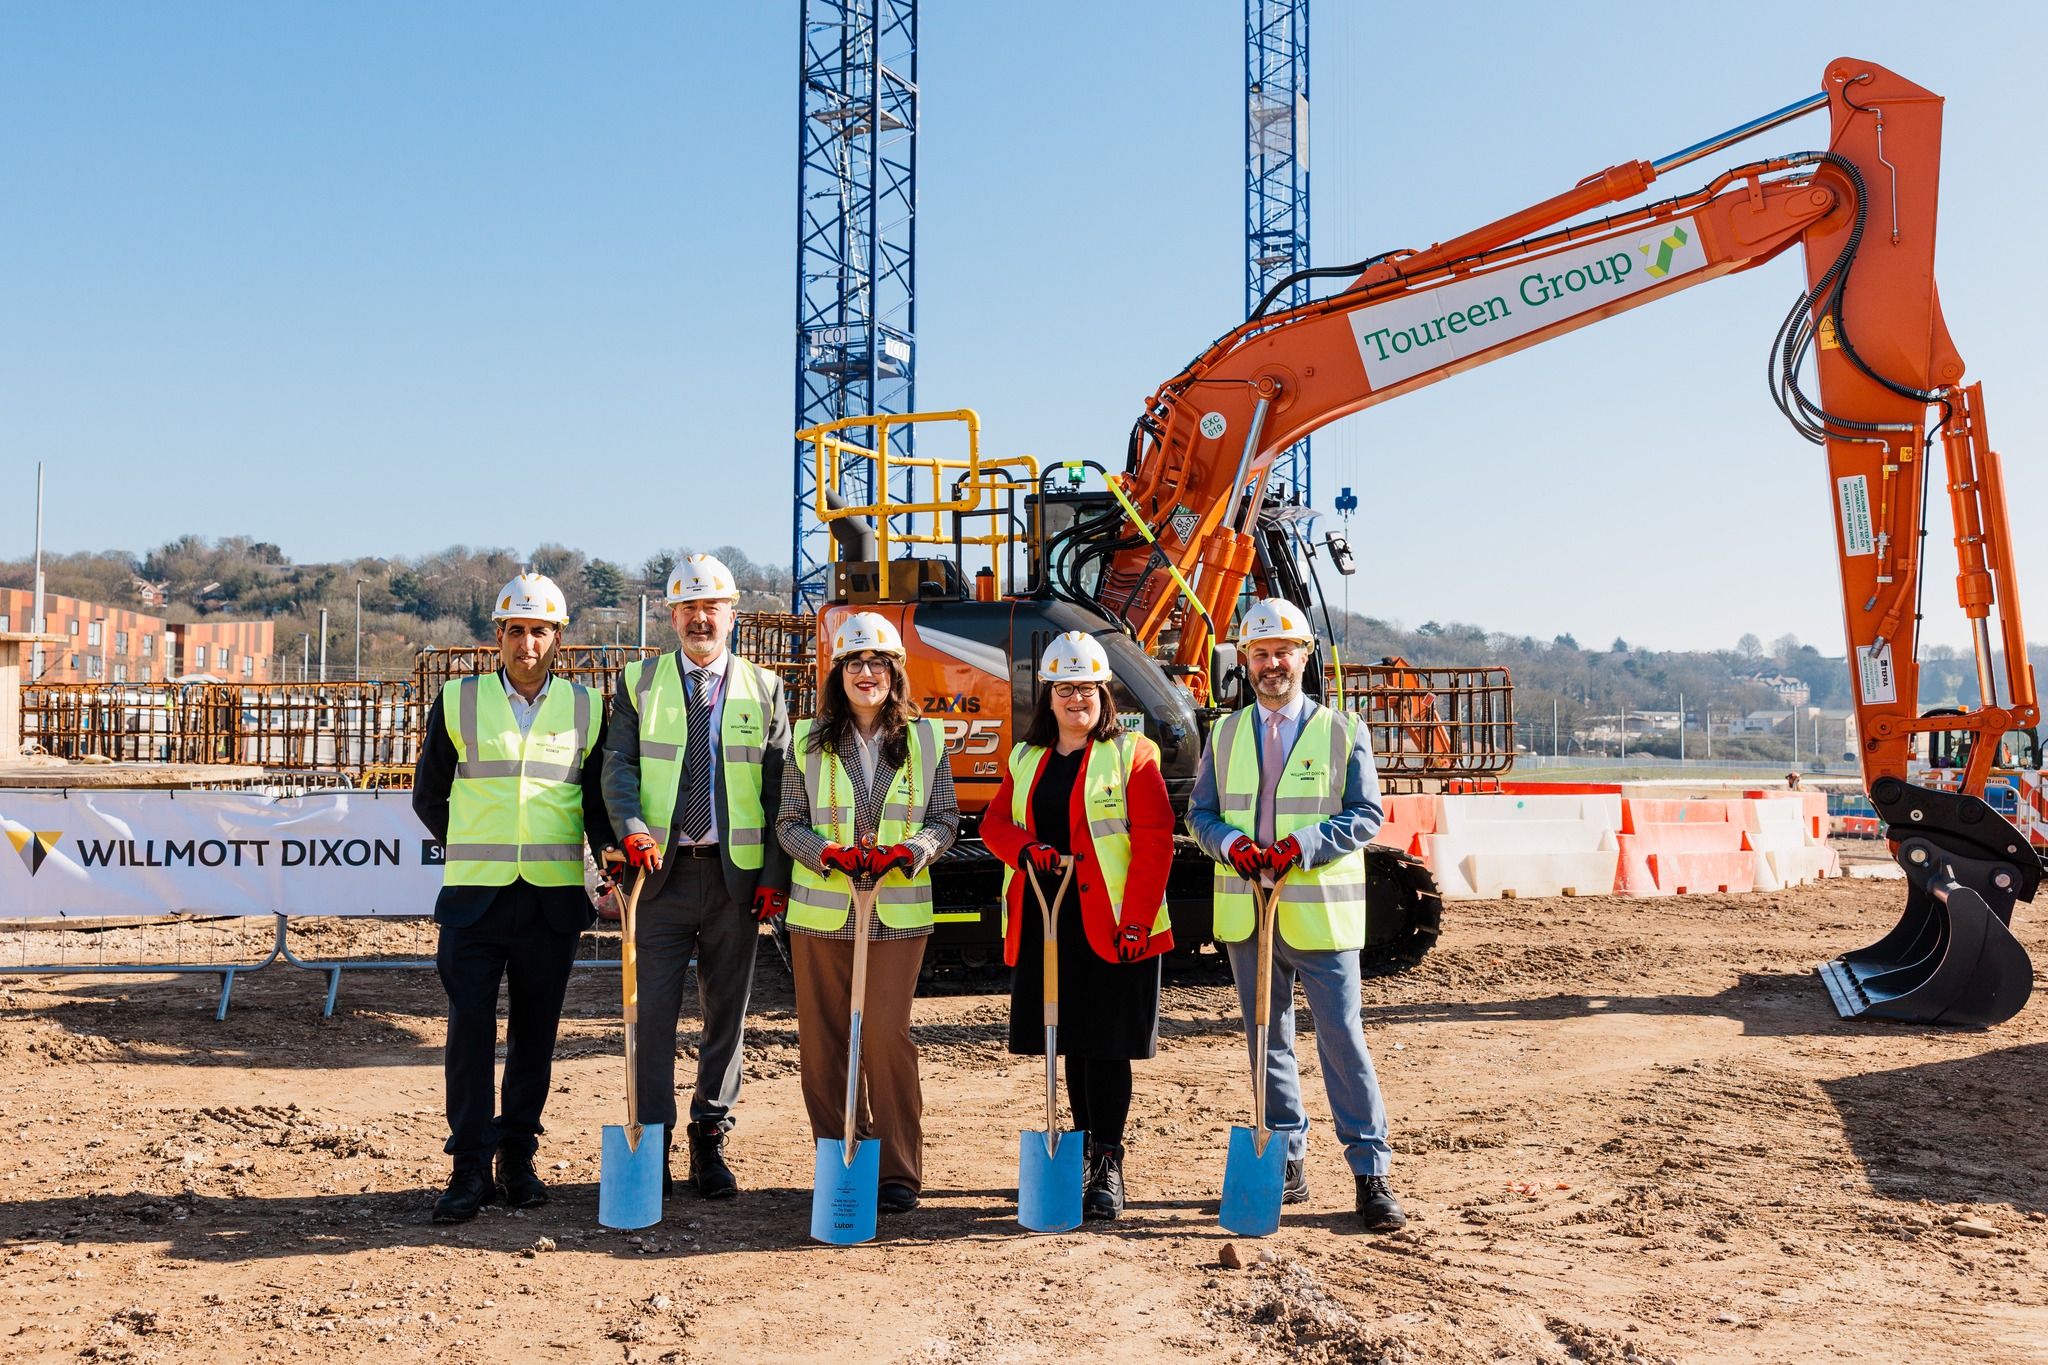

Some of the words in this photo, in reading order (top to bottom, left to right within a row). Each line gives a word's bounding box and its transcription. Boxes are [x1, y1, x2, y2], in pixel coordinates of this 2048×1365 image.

[1364, 296, 1512, 361] Toureen
[1519, 252, 1633, 307] Group
[814, 328, 848, 344] TC01
[1202, 415, 1220, 430] EXC
[1208, 424, 1223, 437] 019
[923, 693, 981, 713] ZAXIS
[1123, 718, 1140, 728] UP
[973, 761, 998, 775] US
[76, 839, 270, 867] WILLMOTT
[281, 839, 400, 866] DIXON
[430, 845, 445, 859] SI
